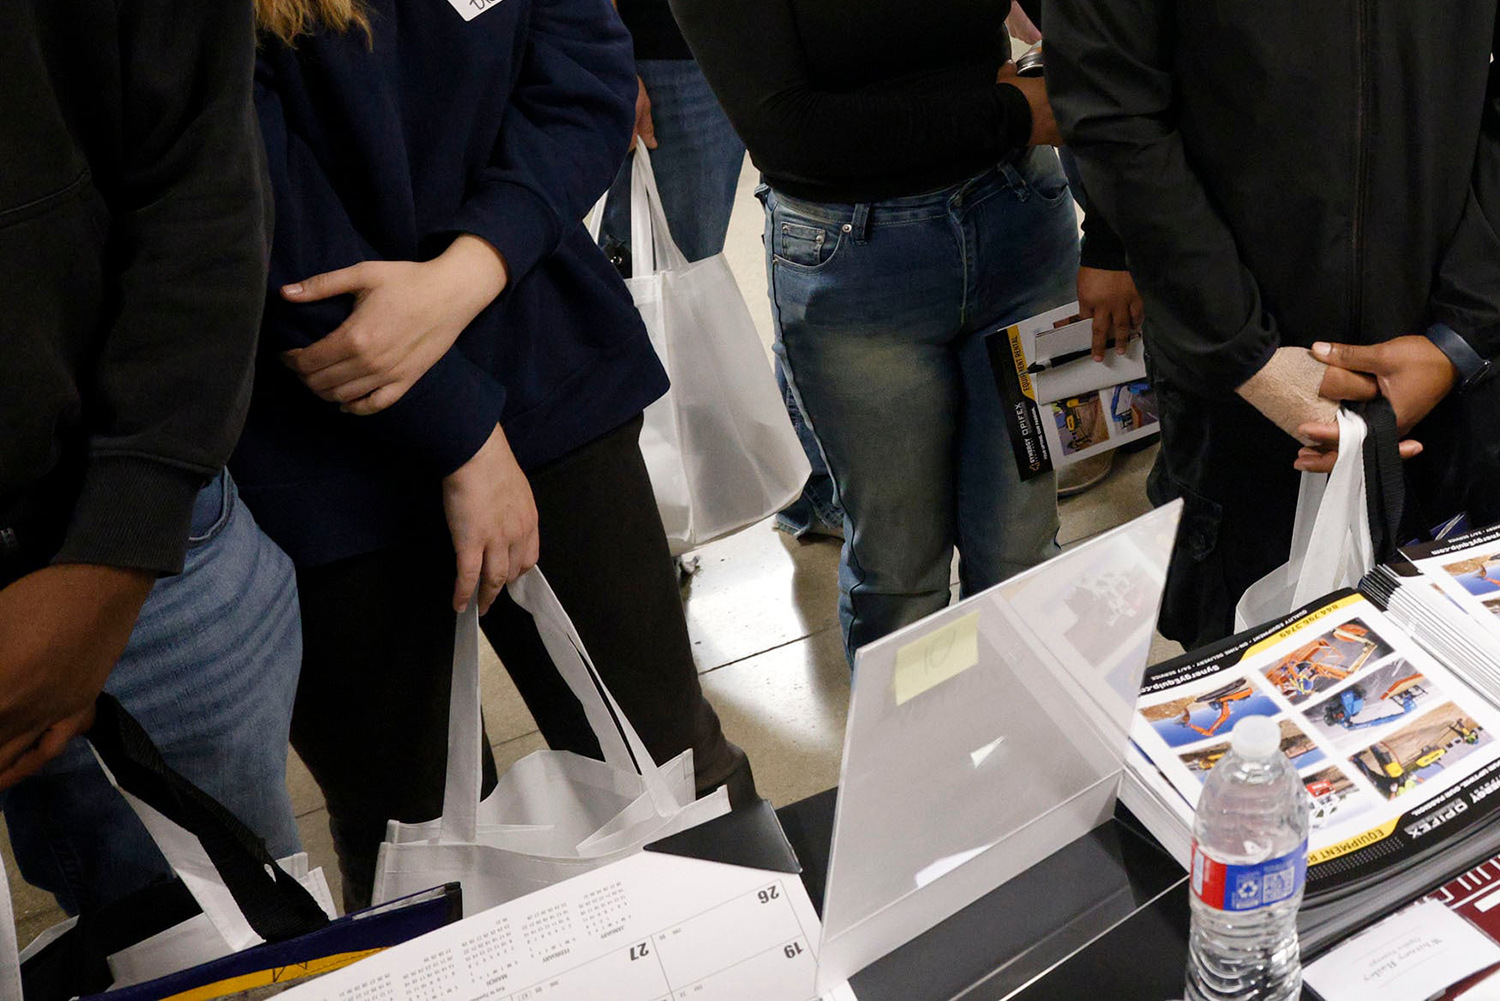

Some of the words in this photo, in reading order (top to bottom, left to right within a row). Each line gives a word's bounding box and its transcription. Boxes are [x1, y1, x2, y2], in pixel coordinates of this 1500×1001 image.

[1016, 359, 1030, 392] EQUIPENT
[1014, 401, 1029, 436] OPIFEX
[1284, 609, 1307, 625] QUALITY
[1253, 621, 1284, 643] EQUIPMENT
[1140, 664, 1220, 694] SynergyEquip.co
[1410, 800, 1468, 839] OPIFEX
[1320, 829, 1385, 861] EQUIPMENT
[757, 885, 780, 904] 26
[600, 925, 625, 940] JANUARY
[629, 942, 649, 961] 27
[783, 941, 804, 959] 19
[486, 974, 508, 987] MARCH
